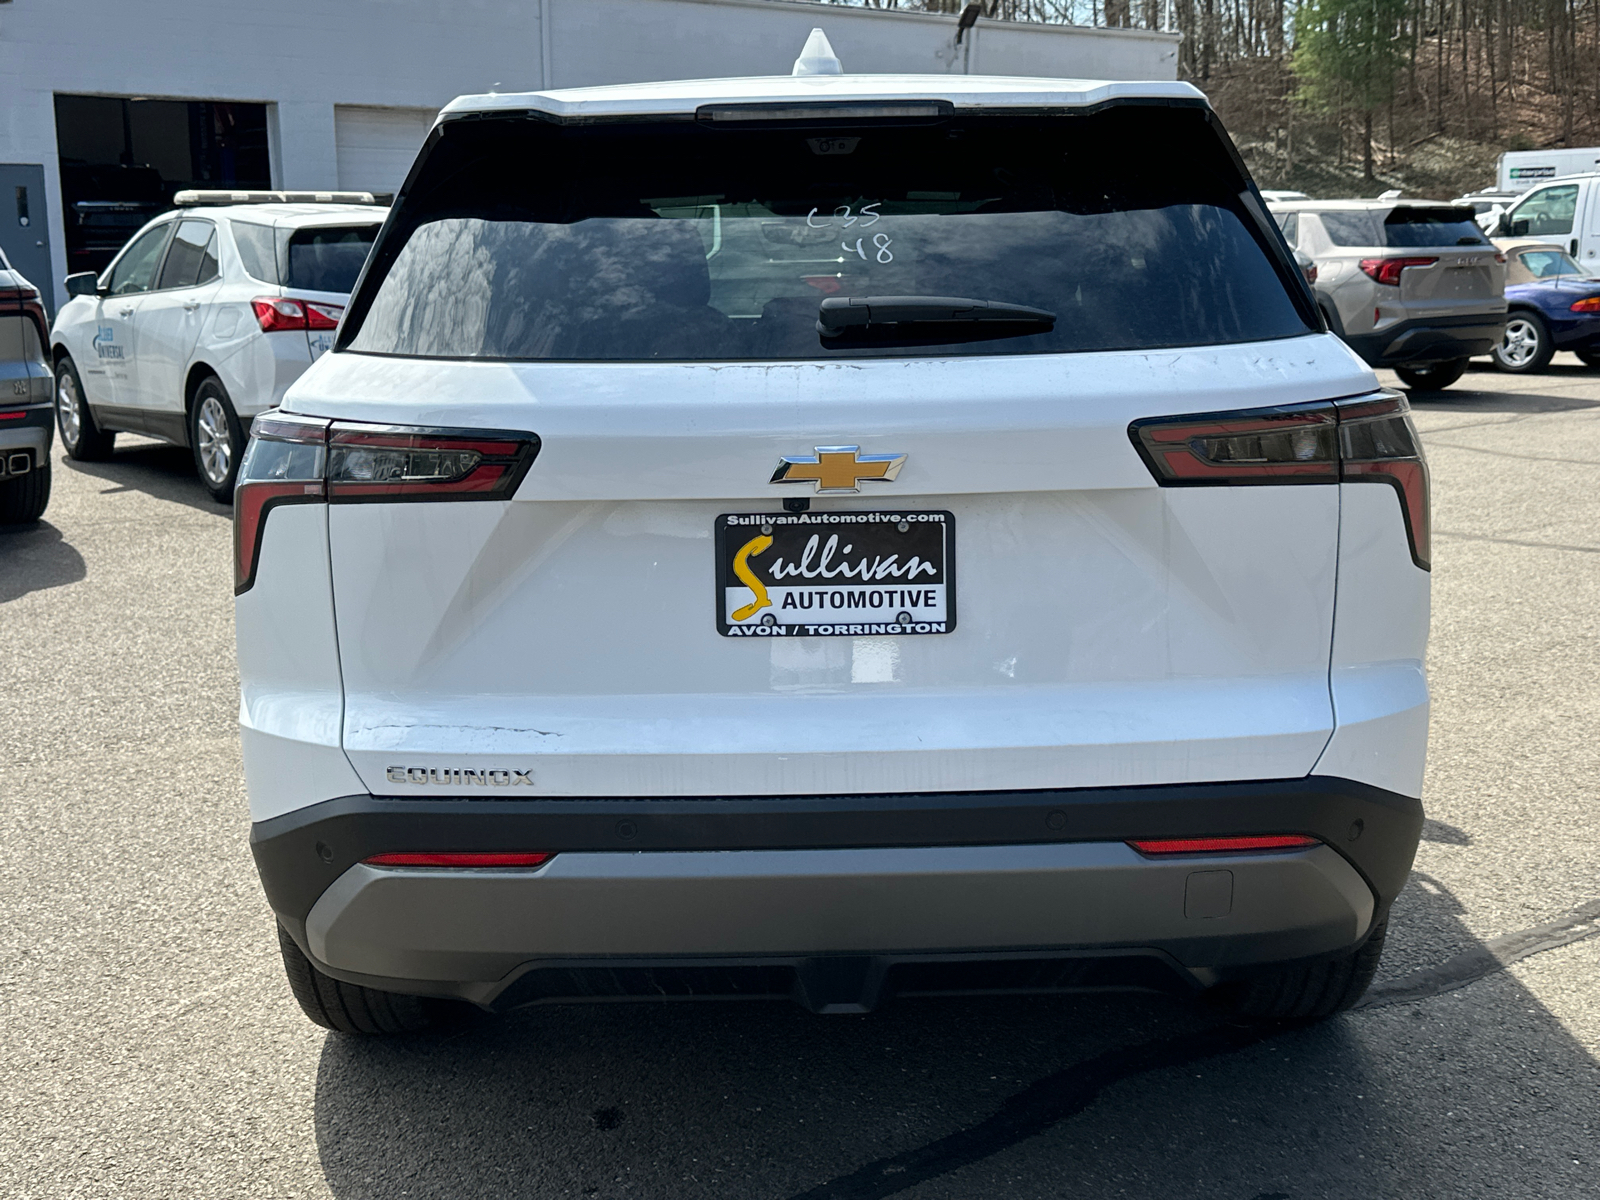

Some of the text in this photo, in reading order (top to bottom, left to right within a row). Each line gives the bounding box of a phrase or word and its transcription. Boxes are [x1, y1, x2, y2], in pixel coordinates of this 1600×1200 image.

[841, 233, 894, 264] 48
[727, 513, 945, 526] SullivanAutomotive.com
[731, 533, 938, 622] Sullivan
[781, 590, 937, 610] AUTOMOTIVE
[727, 624, 787, 636] AVON
[804, 622, 947, 636] TORRINGTON
[386, 765, 535, 787] EQUINOX
